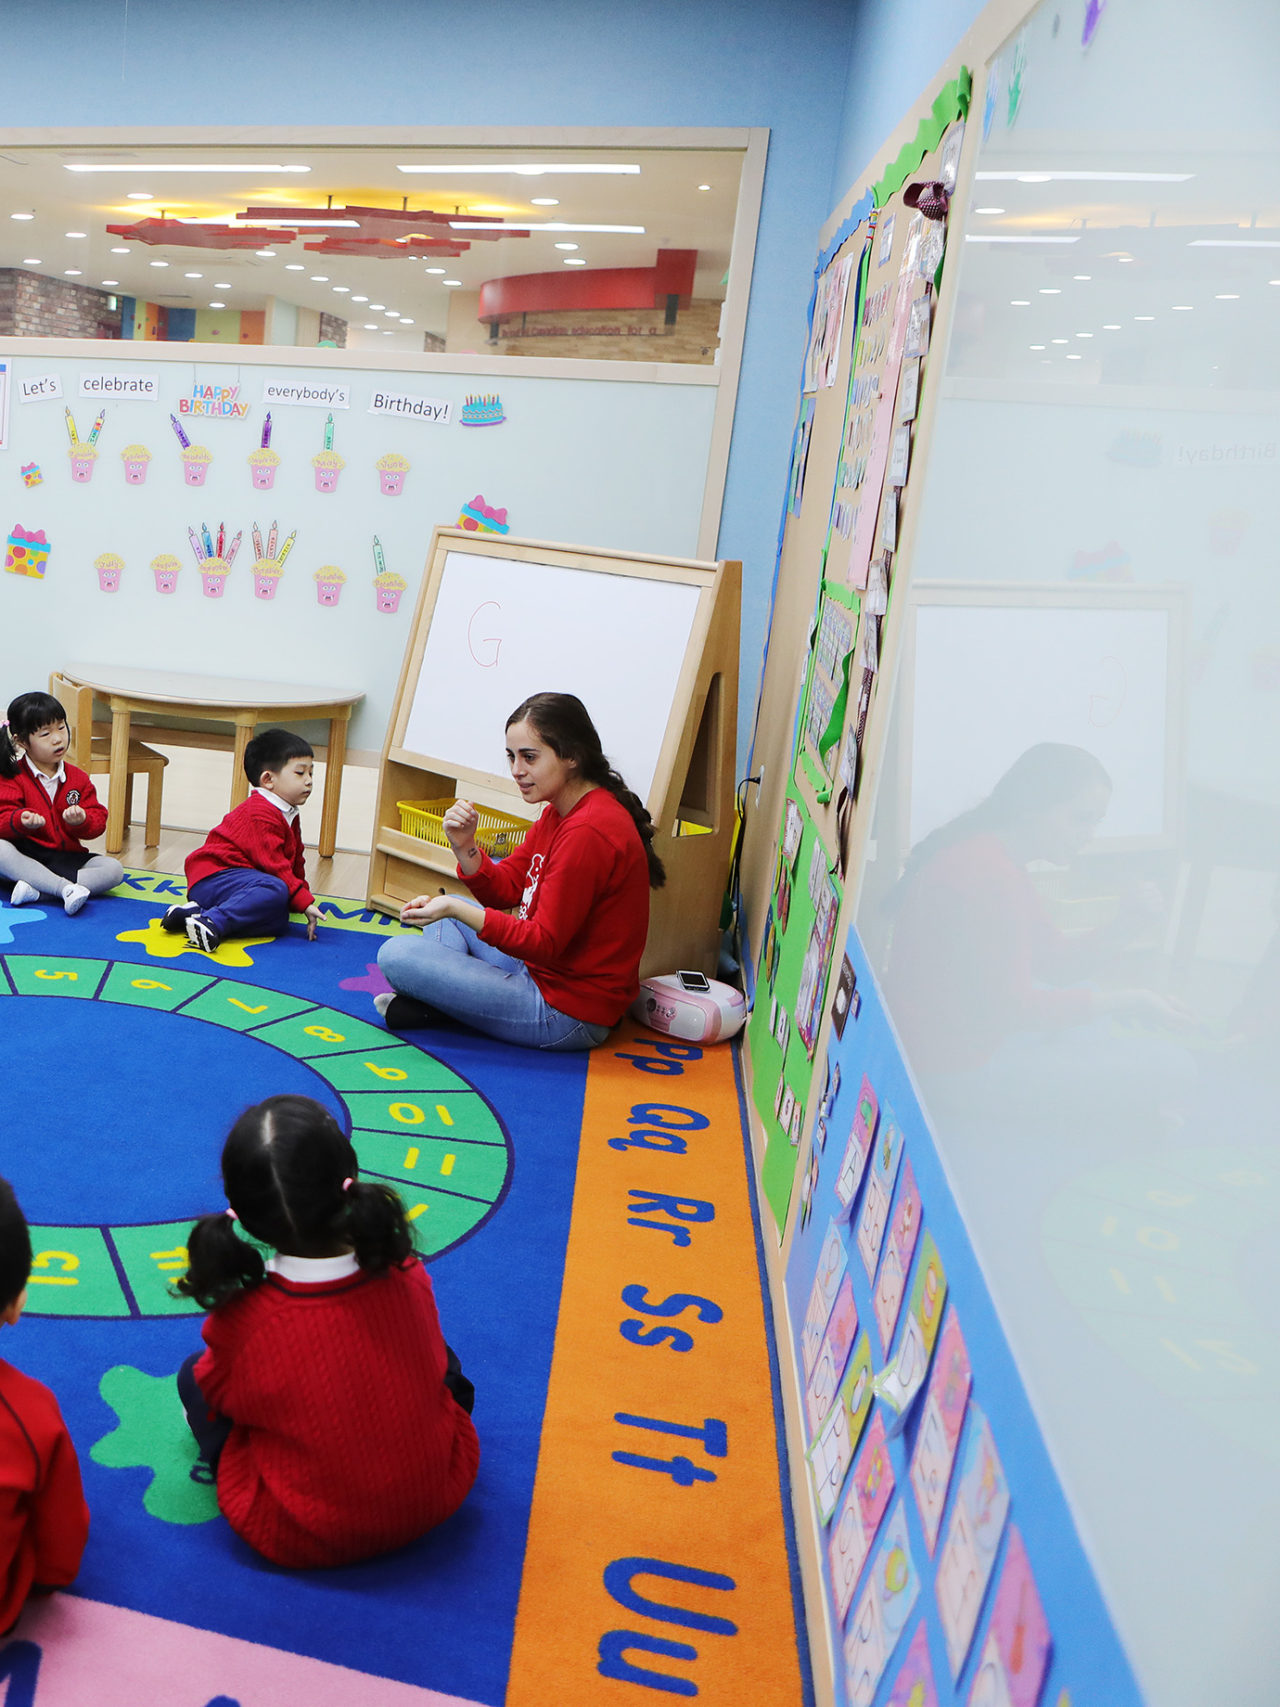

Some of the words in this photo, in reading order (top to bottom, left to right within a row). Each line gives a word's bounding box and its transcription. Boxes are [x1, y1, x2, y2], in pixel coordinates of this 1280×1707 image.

[627, 325, 642, 336] for
[649, 327, 658, 336] a
[22, 377, 57, 396] Let's
[82, 376, 154, 392] celebrate
[192, 384, 239, 401] HAPPY
[266, 384, 346, 404] everybody's
[179, 399, 249, 417] BIRTHDAY
[372, 393, 450, 420] Birthday!
[467, 601, 503, 668] G
[33, 968, 78, 982] 5
[131, 978, 173, 991] 6
[227, 997, 269, 1015] 7
[303, 1025, 347, 1043] 8
[614, 1038, 704, 1076] Pp
[364, 1061, 408, 1081] 9
[389, 1102, 455, 1127] 10
[608, 1102, 710, 1155] Qq
[403, 1146, 457, 1176] 11
[627, 1189, 715, 1248] Rr
[619, 1284, 723, 1352] Ss
[611, 1412, 728, 1486] Tt
[596, 1556, 739, 1698] Uu
